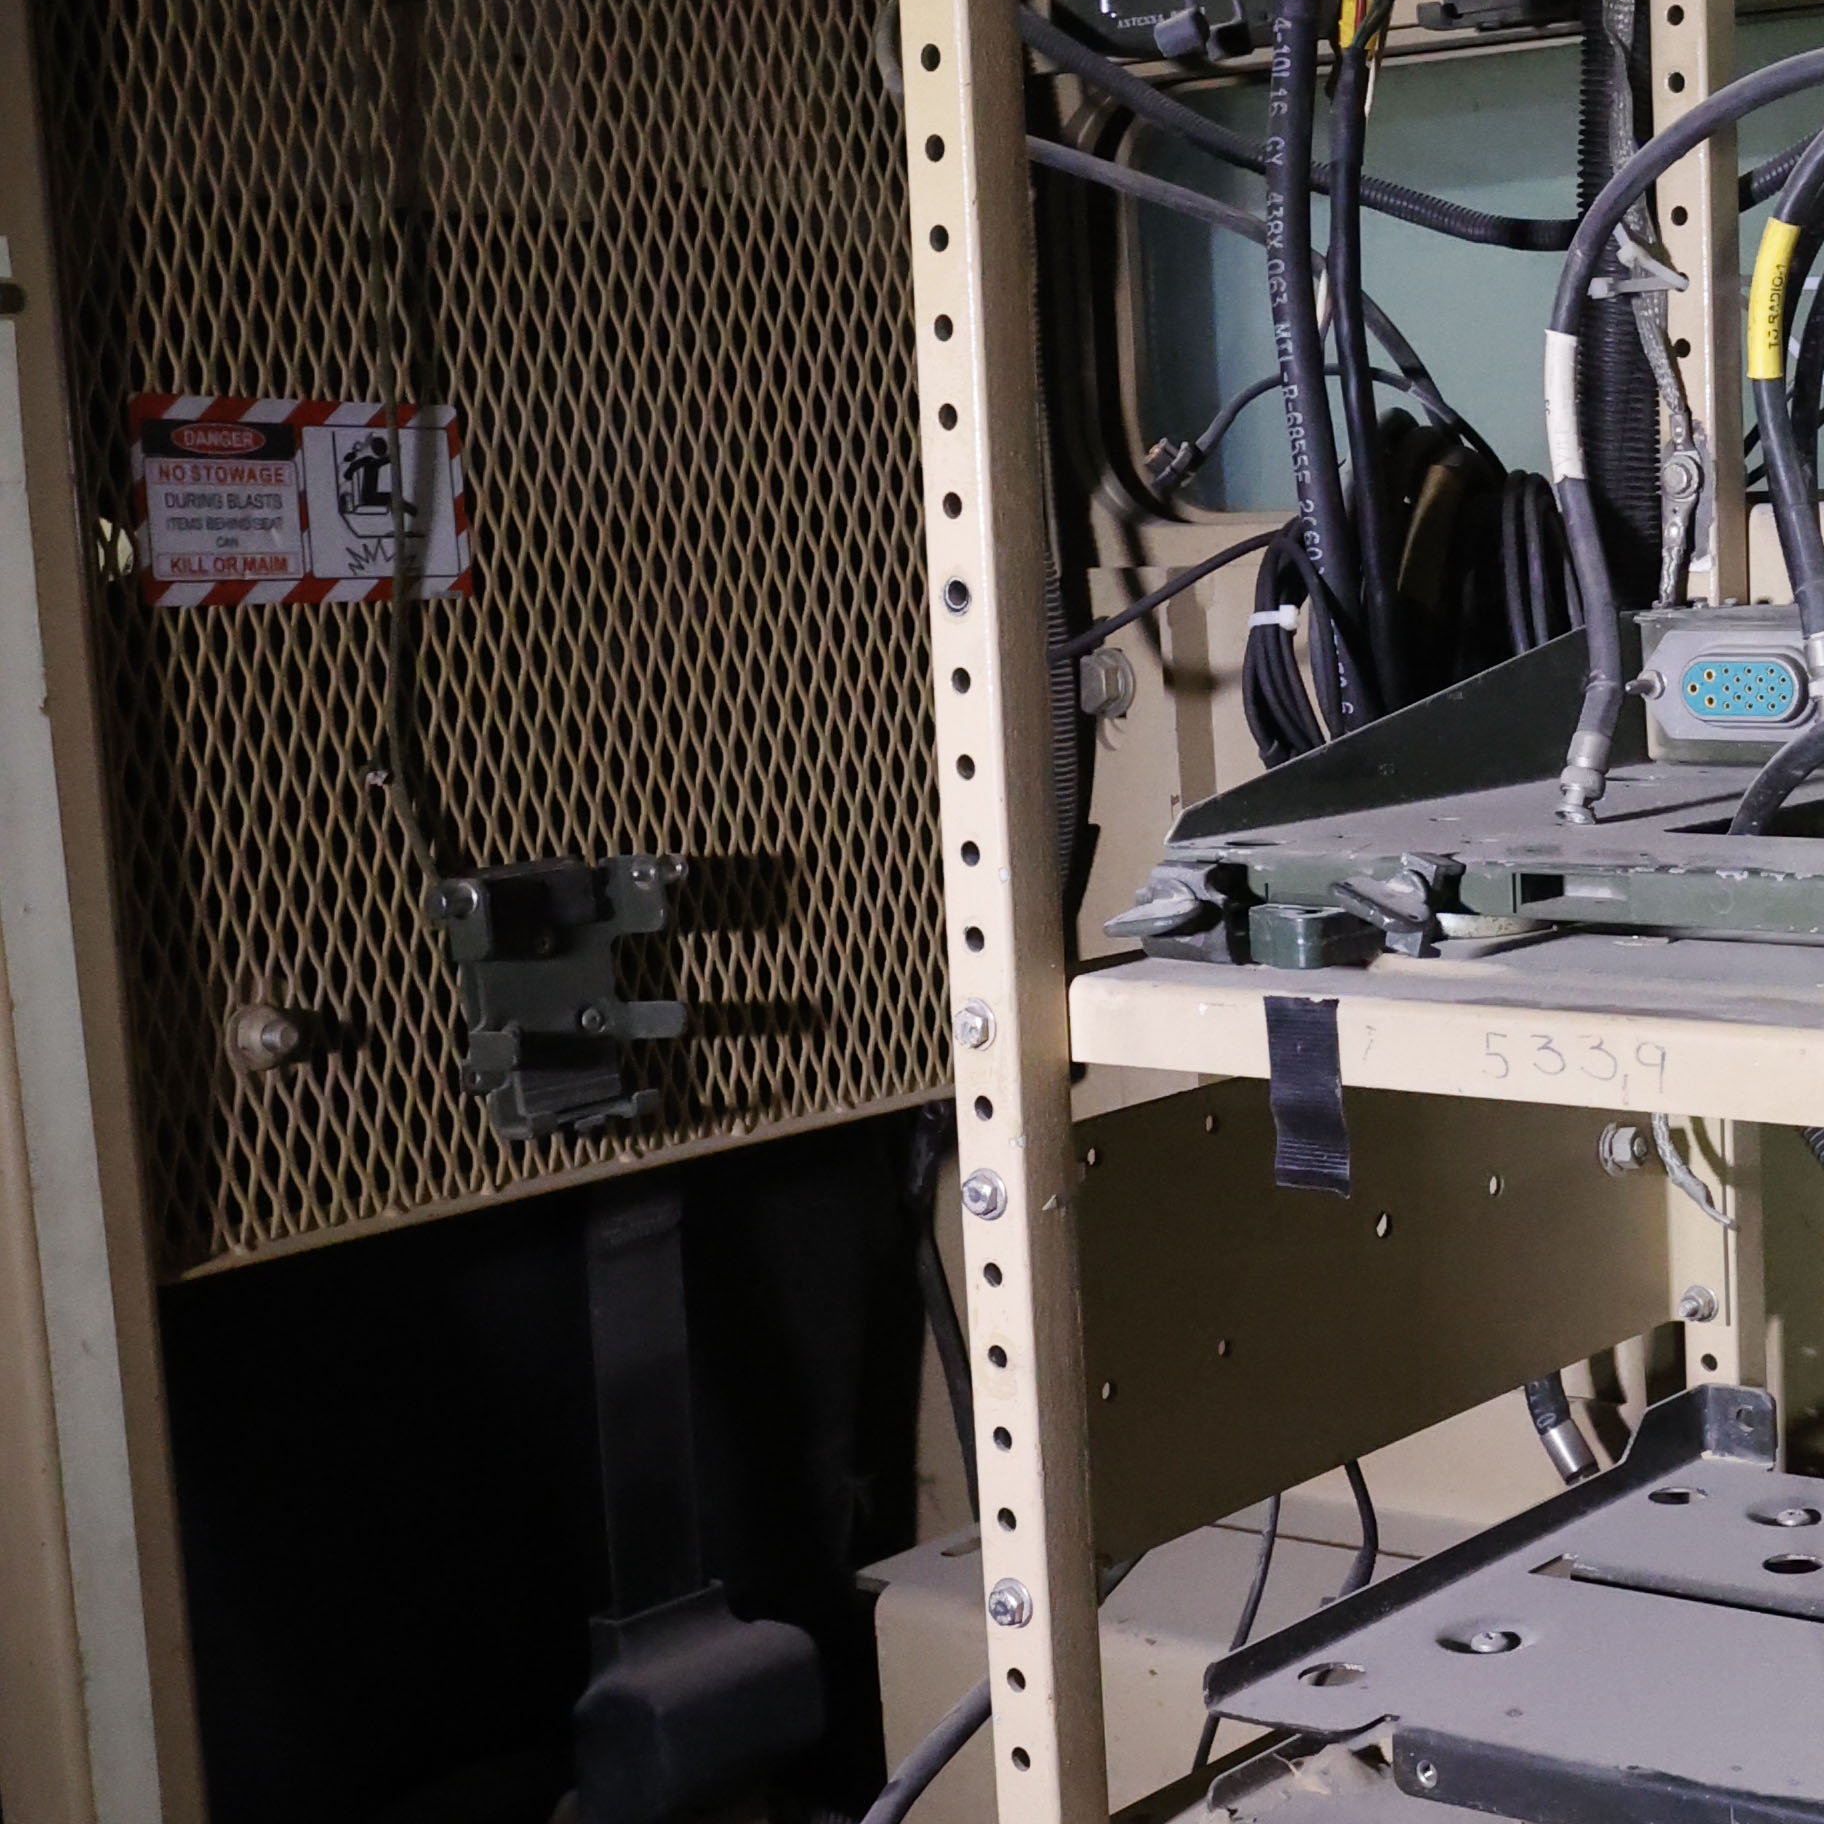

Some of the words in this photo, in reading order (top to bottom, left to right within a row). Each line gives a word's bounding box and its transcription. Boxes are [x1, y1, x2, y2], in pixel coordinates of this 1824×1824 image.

[183, 431, 254, 449] DANGER
[158, 464, 186, 483] NO
[189, 465, 285, 484] STOWAGE
[164, 492, 223, 510] DURING
[226, 492, 283, 511] BLASTS
[215, 536, 239, 548] CAN
[170, 555, 211, 574] KILL
[212, 555, 238, 574] OR
[243, 555, 289, 574] MAIM
